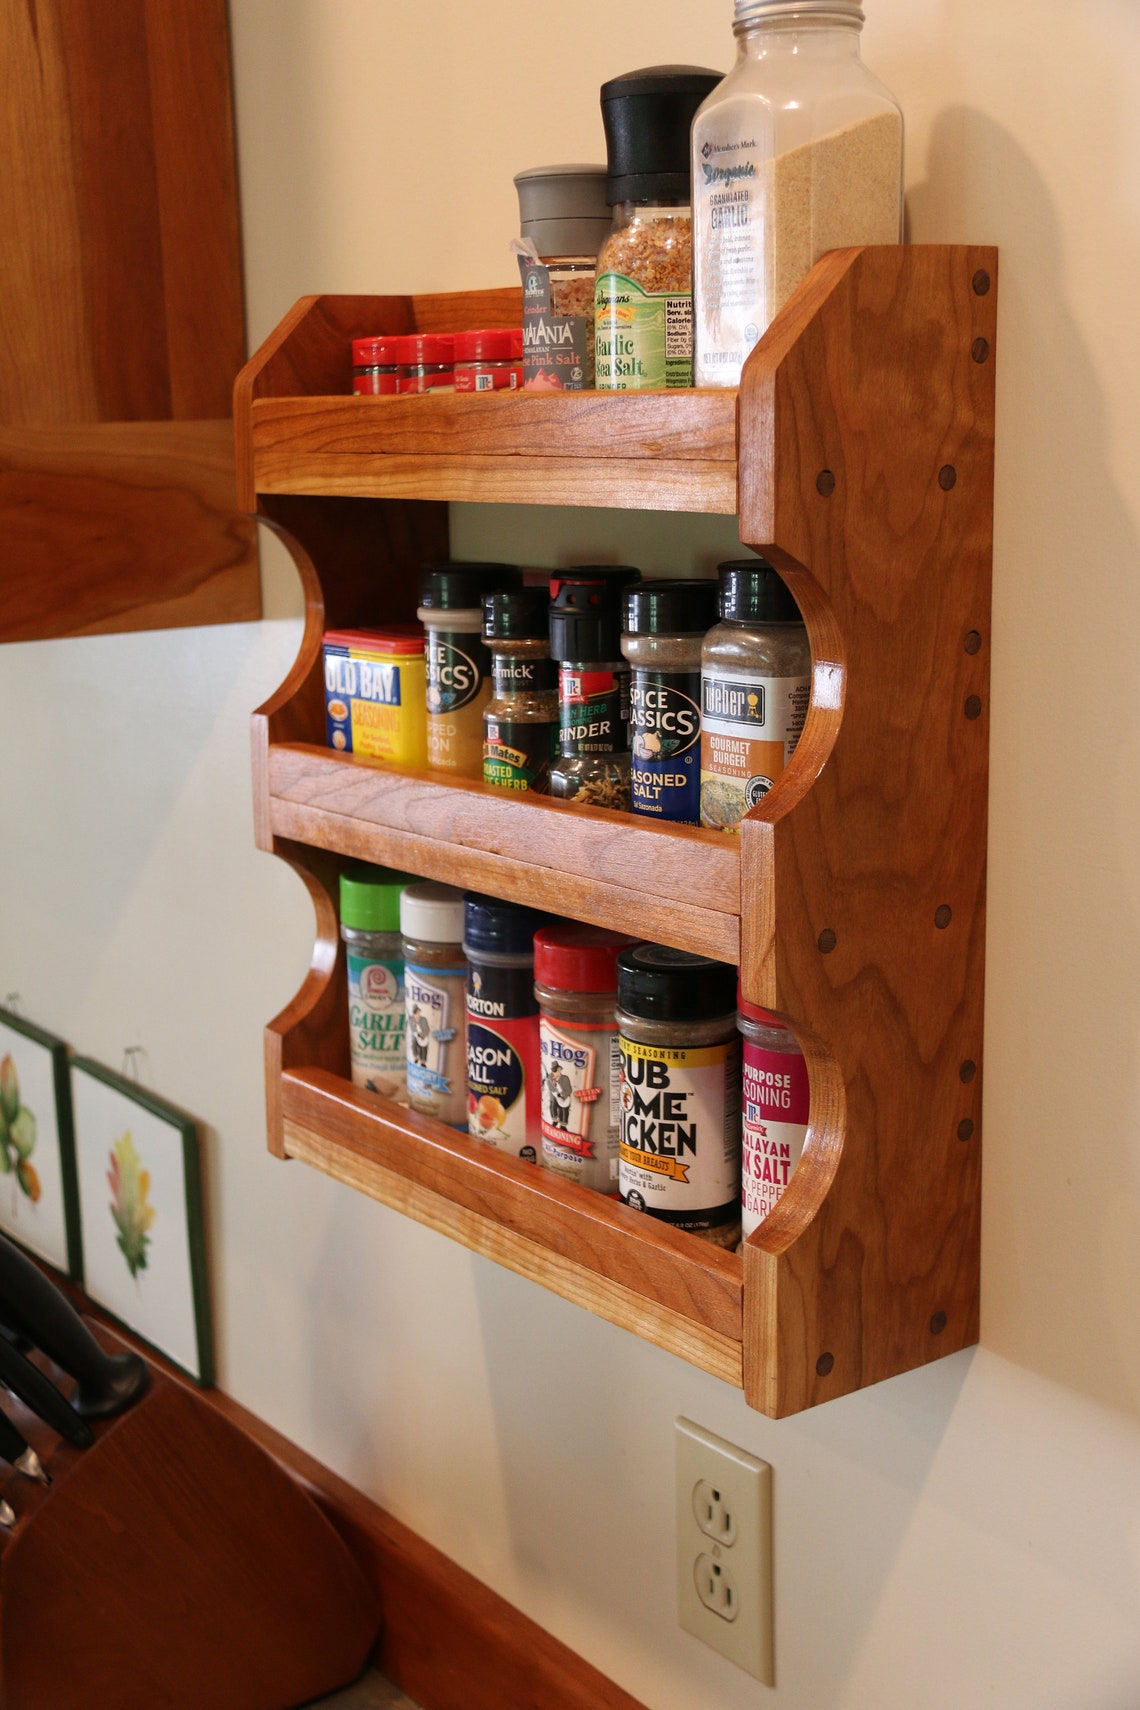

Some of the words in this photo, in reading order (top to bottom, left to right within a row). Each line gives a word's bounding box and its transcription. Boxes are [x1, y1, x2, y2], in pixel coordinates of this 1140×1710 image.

[709, 190, 749, 206] GRANULATED
[711, 203, 748, 230] GARLIC
[596, 334, 635, 356] Garlic
[531, 352, 553, 366] Pink
[556, 352, 580, 365] Salt
[615, 357, 644, 377] Salt
[324, 658, 357, 696] OLD
[359, 663, 395, 703] BAY
[630, 687, 668, 710] SPICE
[580, 703, 607, 718] HERB
[559, 720, 611, 743] RINDER
[491, 745, 521, 763] Mates
[709, 736, 751, 756] GOURMET
[713, 750, 747, 768] BURGER
[708, 763, 752, 779] SEASONING
[501, 778, 528, 791] HERB
[633, 783, 662, 800] SALT
[411, 986, 442, 1010] Hog
[358, 1030, 405, 1052] SALT
[550, 1039, 586, 1068] Hog
[633, 1045, 687, 1060] SEASONING
[744, 1062, 791, 1089] PURPOSE
[643, 1154, 670, 1171] BREASTS
[753, 1154, 791, 1186] SALT
[648, 1182, 667, 1192] Garlic
[751, 1179, 786, 1201] PEPPE
